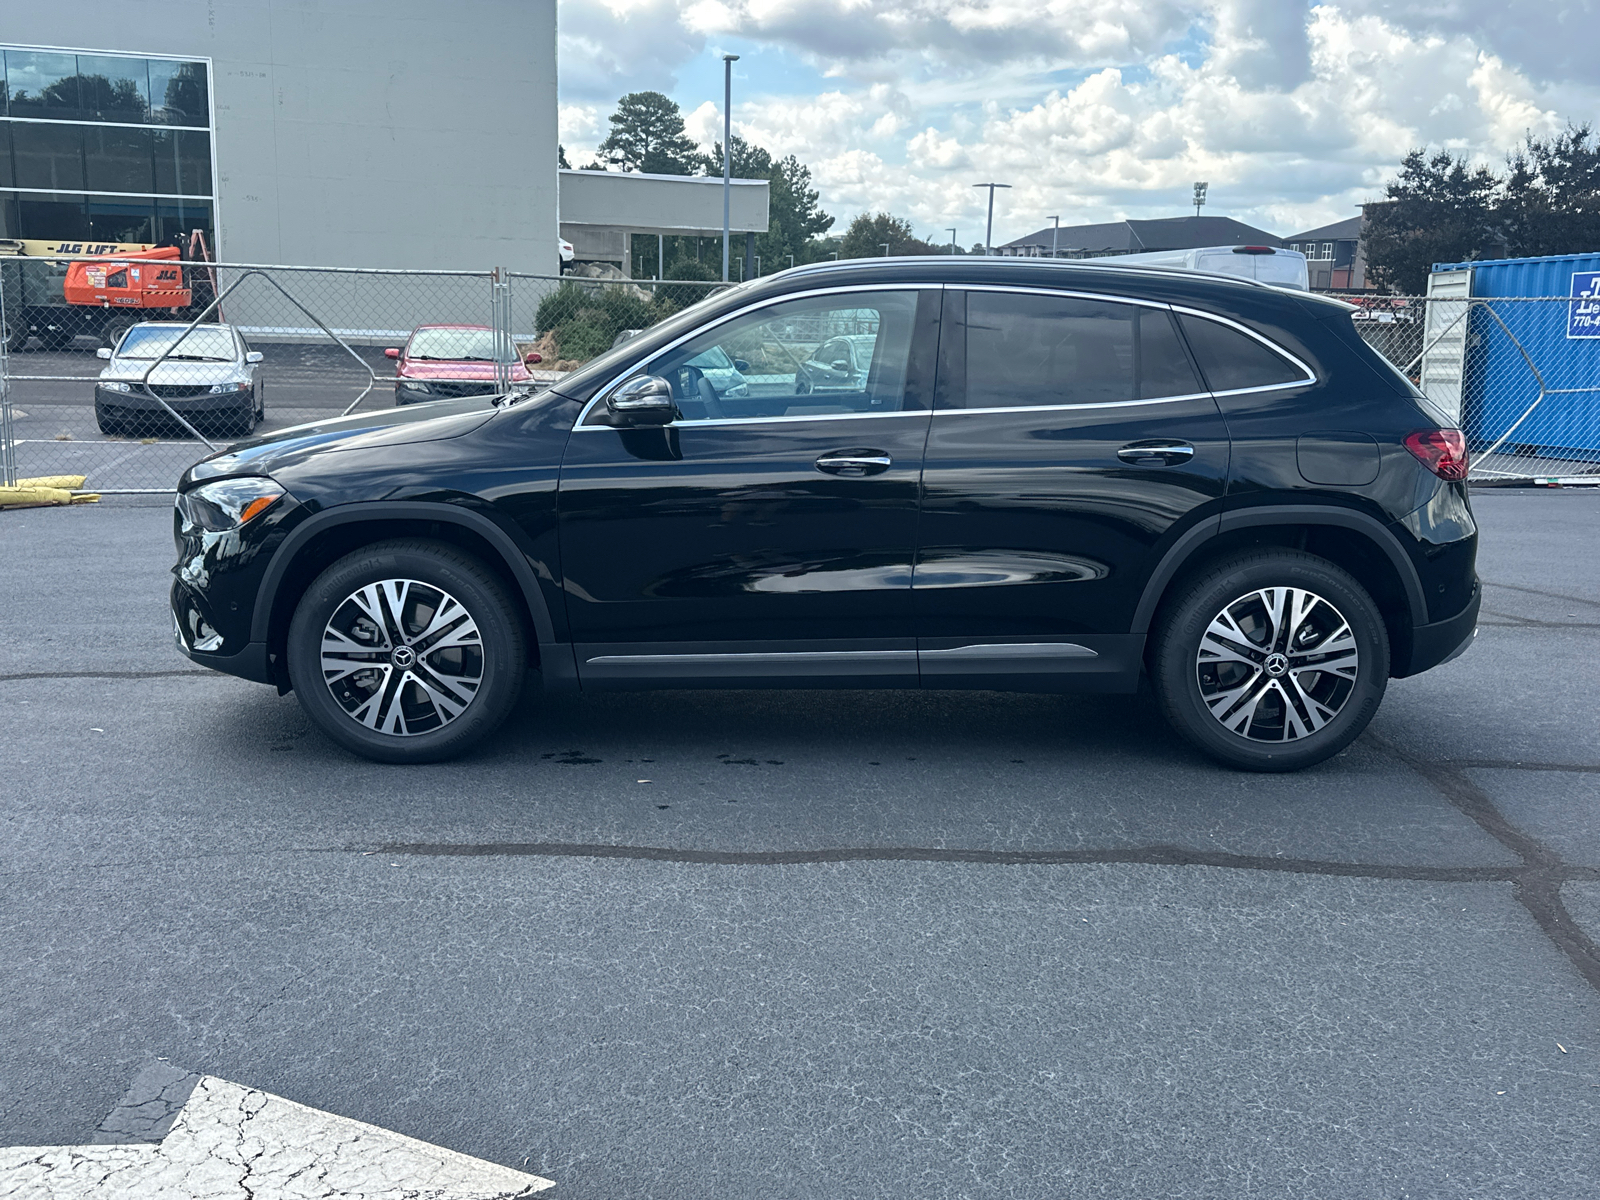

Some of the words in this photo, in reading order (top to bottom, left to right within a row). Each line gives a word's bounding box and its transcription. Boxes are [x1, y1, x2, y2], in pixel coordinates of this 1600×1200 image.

[56, 243, 83, 254] JLG
[85, 244, 118, 254] LIFT
[156, 270, 178, 281] JLG
[319, 559, 374, 600] Continental
[1184, 583, 1229, 635] Continental
